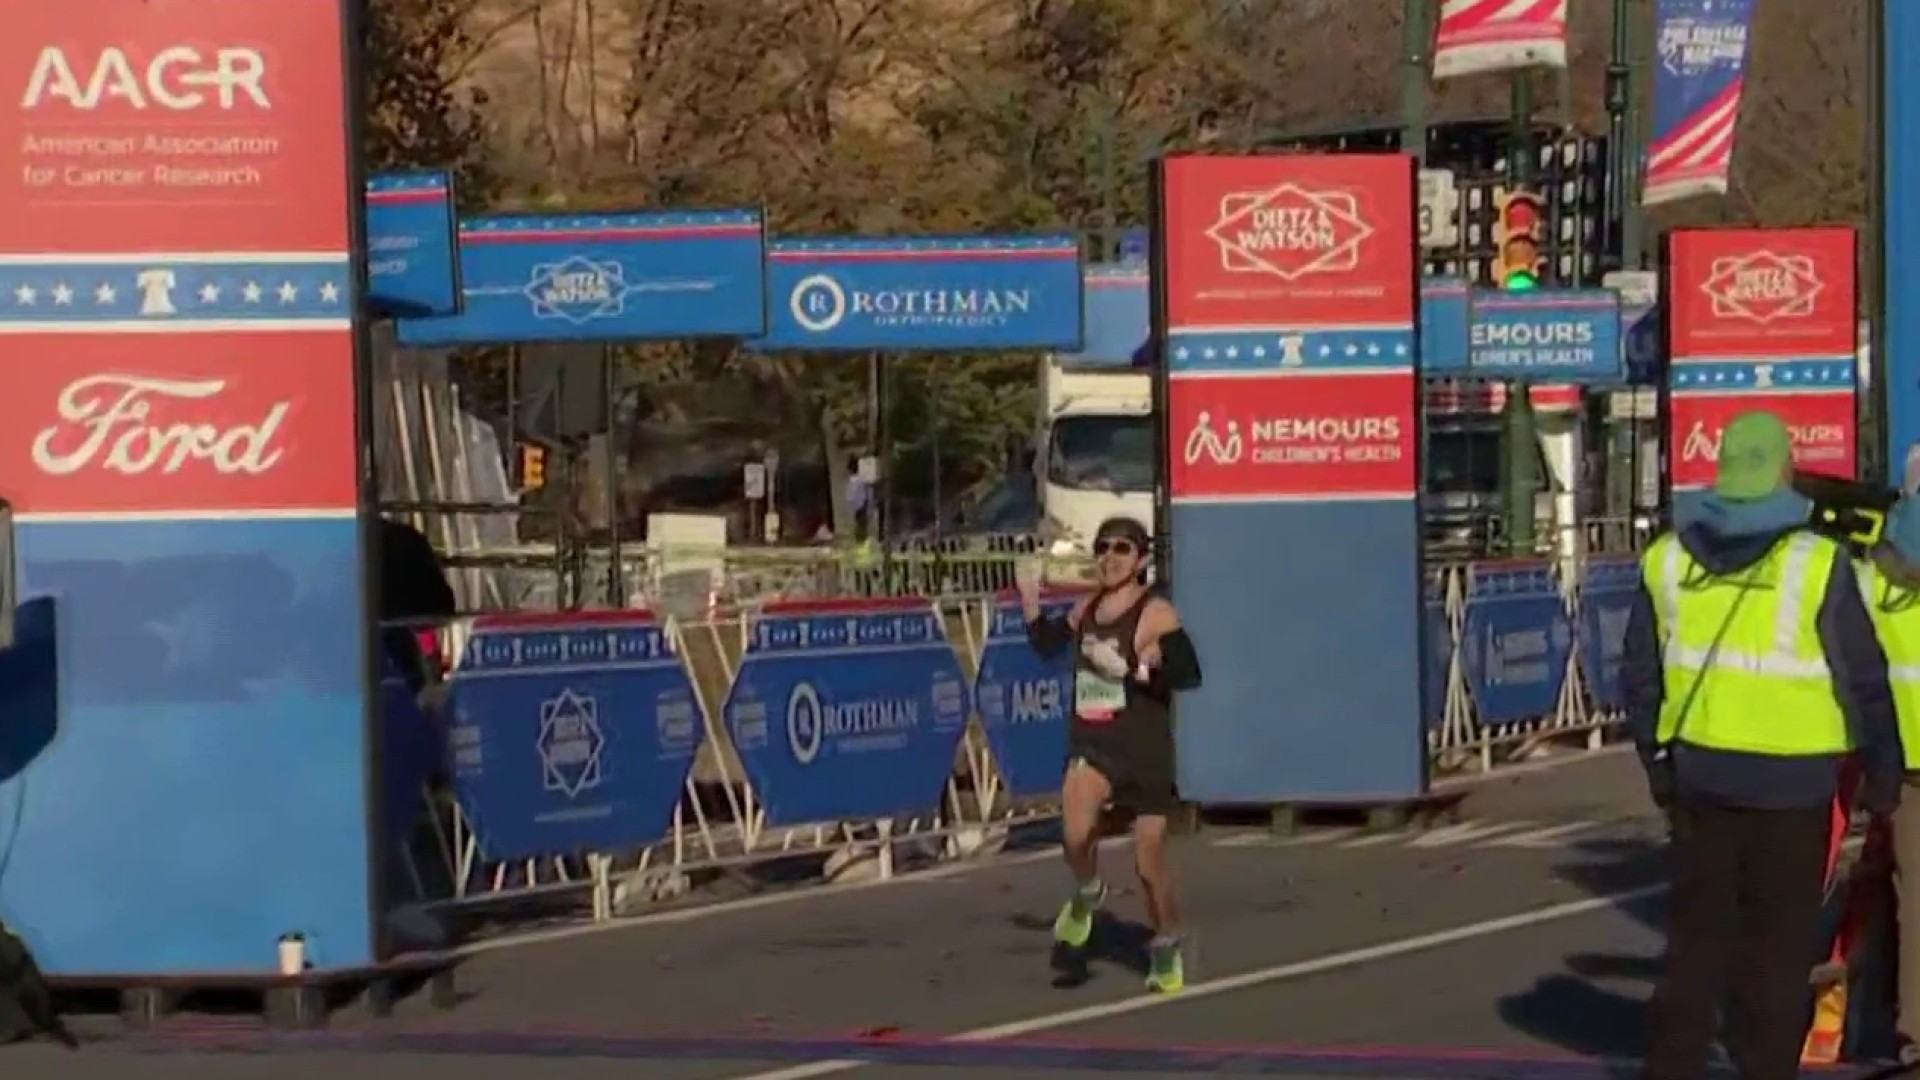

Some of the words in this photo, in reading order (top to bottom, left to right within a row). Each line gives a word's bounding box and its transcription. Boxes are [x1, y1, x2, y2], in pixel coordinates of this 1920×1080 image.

[20, 46, 271, 109] AACR
[22, 133, 134, 154] American
[144, 133, 279, 154] Association
[23, 166, 56, 185] for
[64, 166, 144, 185] Cancer
[154, 165, 260, 186] Research
[1237, 230, 1335, 250] WATSON
[852, 289, 1030, 314] ROTHMAN
[1471, 321, 1593, 345] EMOURS
[32, 372, 290, 475] Ford
[1252, 416, 1400, 442] NEMOURS
[823, 699, 919, 735] ROTHMAN
